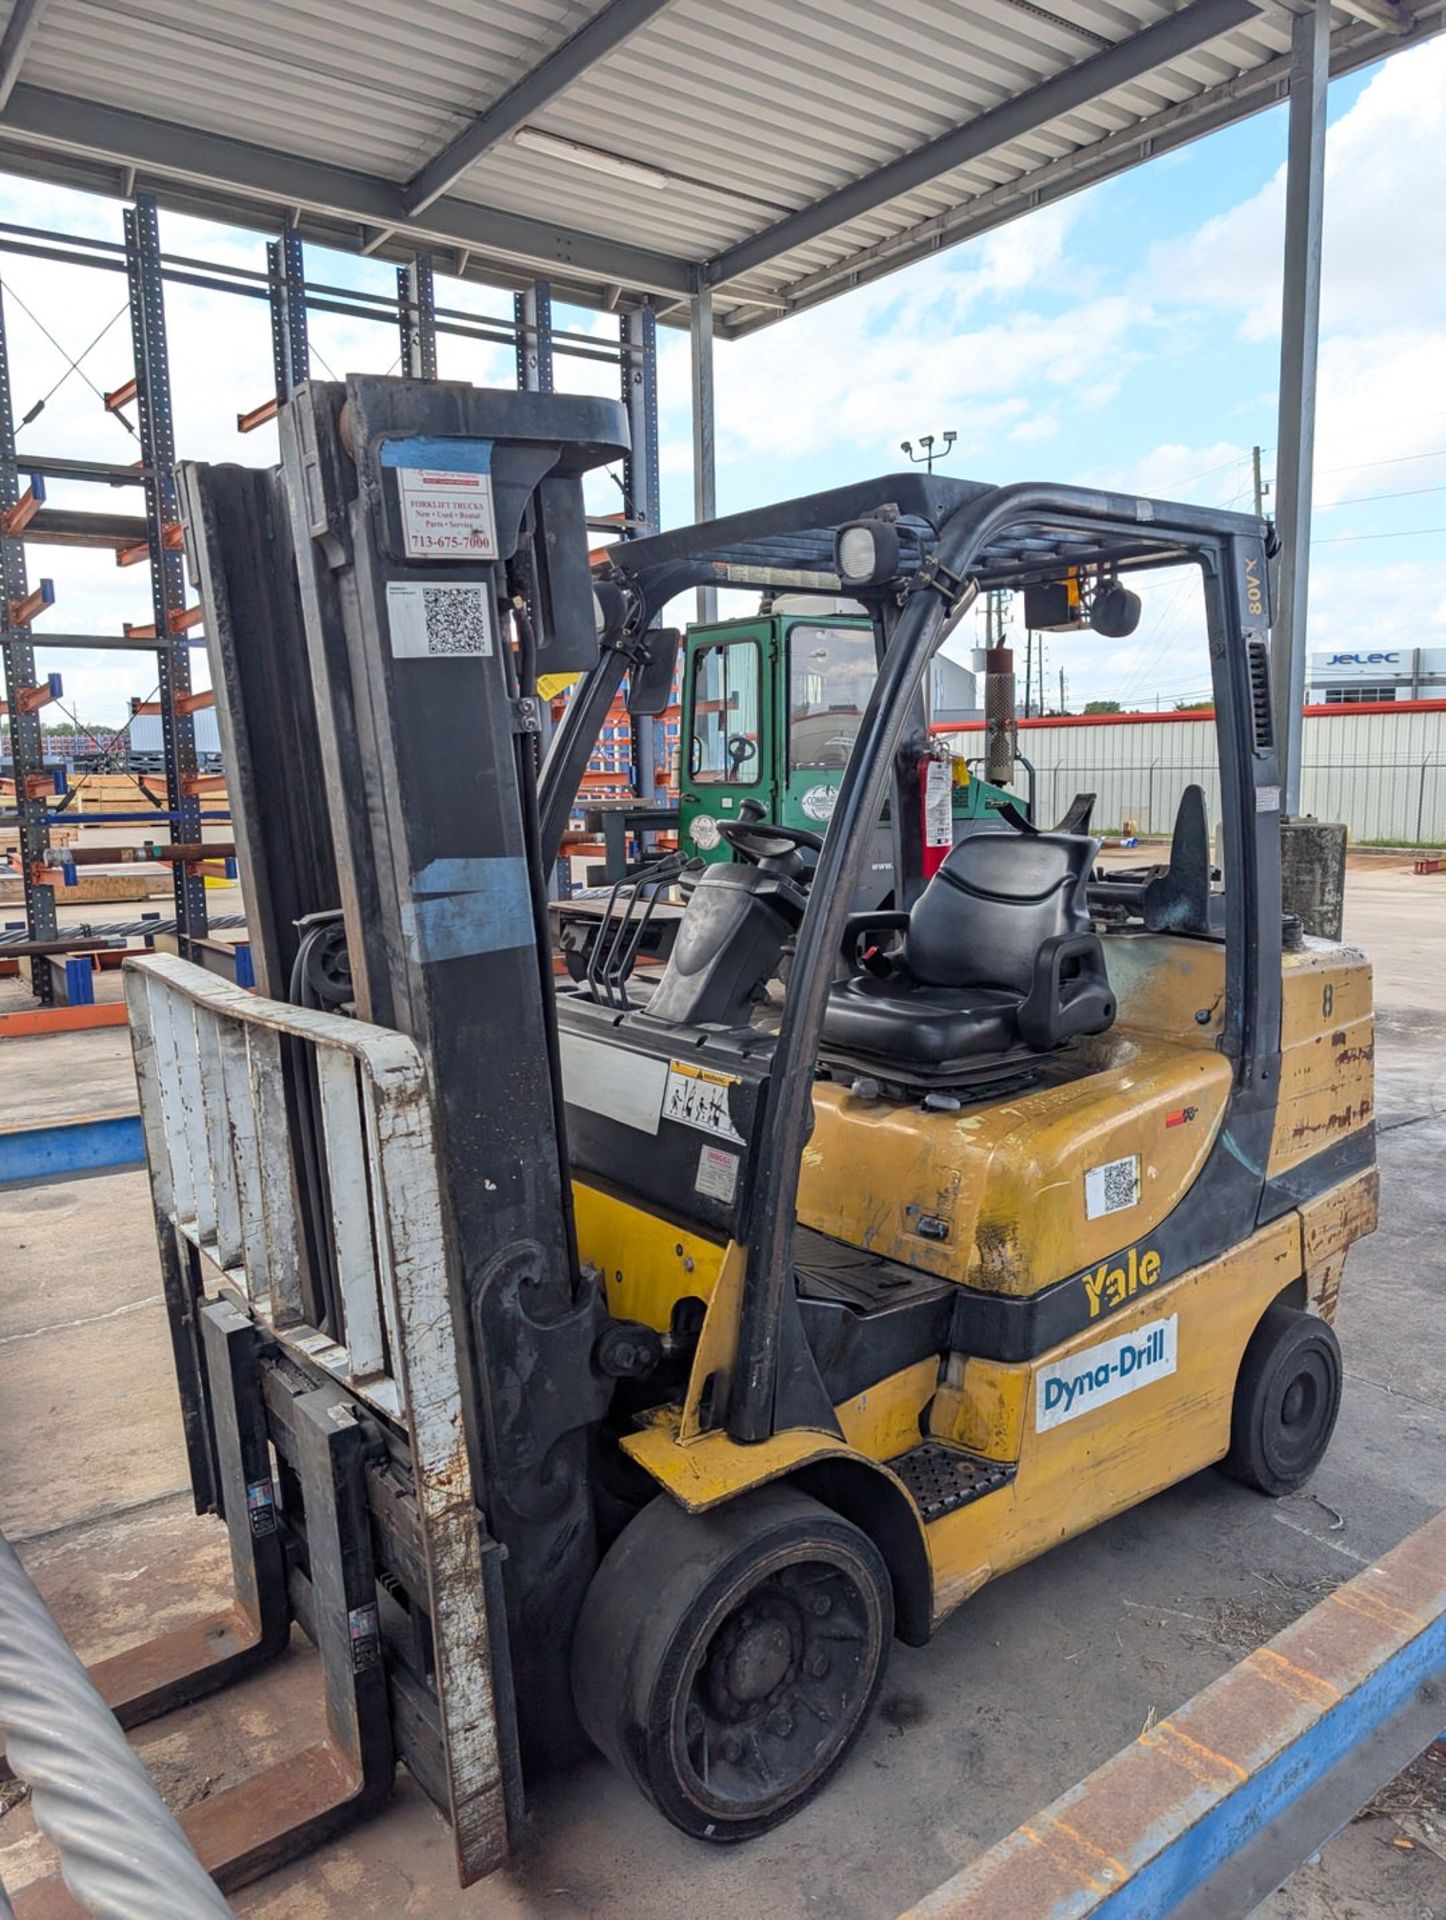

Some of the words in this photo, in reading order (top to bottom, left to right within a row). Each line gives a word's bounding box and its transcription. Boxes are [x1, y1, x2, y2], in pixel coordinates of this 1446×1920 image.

[410, 500, 451, 509] FORKLIFT
[453, 502, 484, 511] TRUCKS
[415, 510, 431, 518] New
[425, 520, 444, 528] Parts
[411, 535, 490, 549] 713-675-7000
[1081, 1247, 1161, 1318] Yale
[1044, 1328, 1165, 1412] Dyna-Drill
